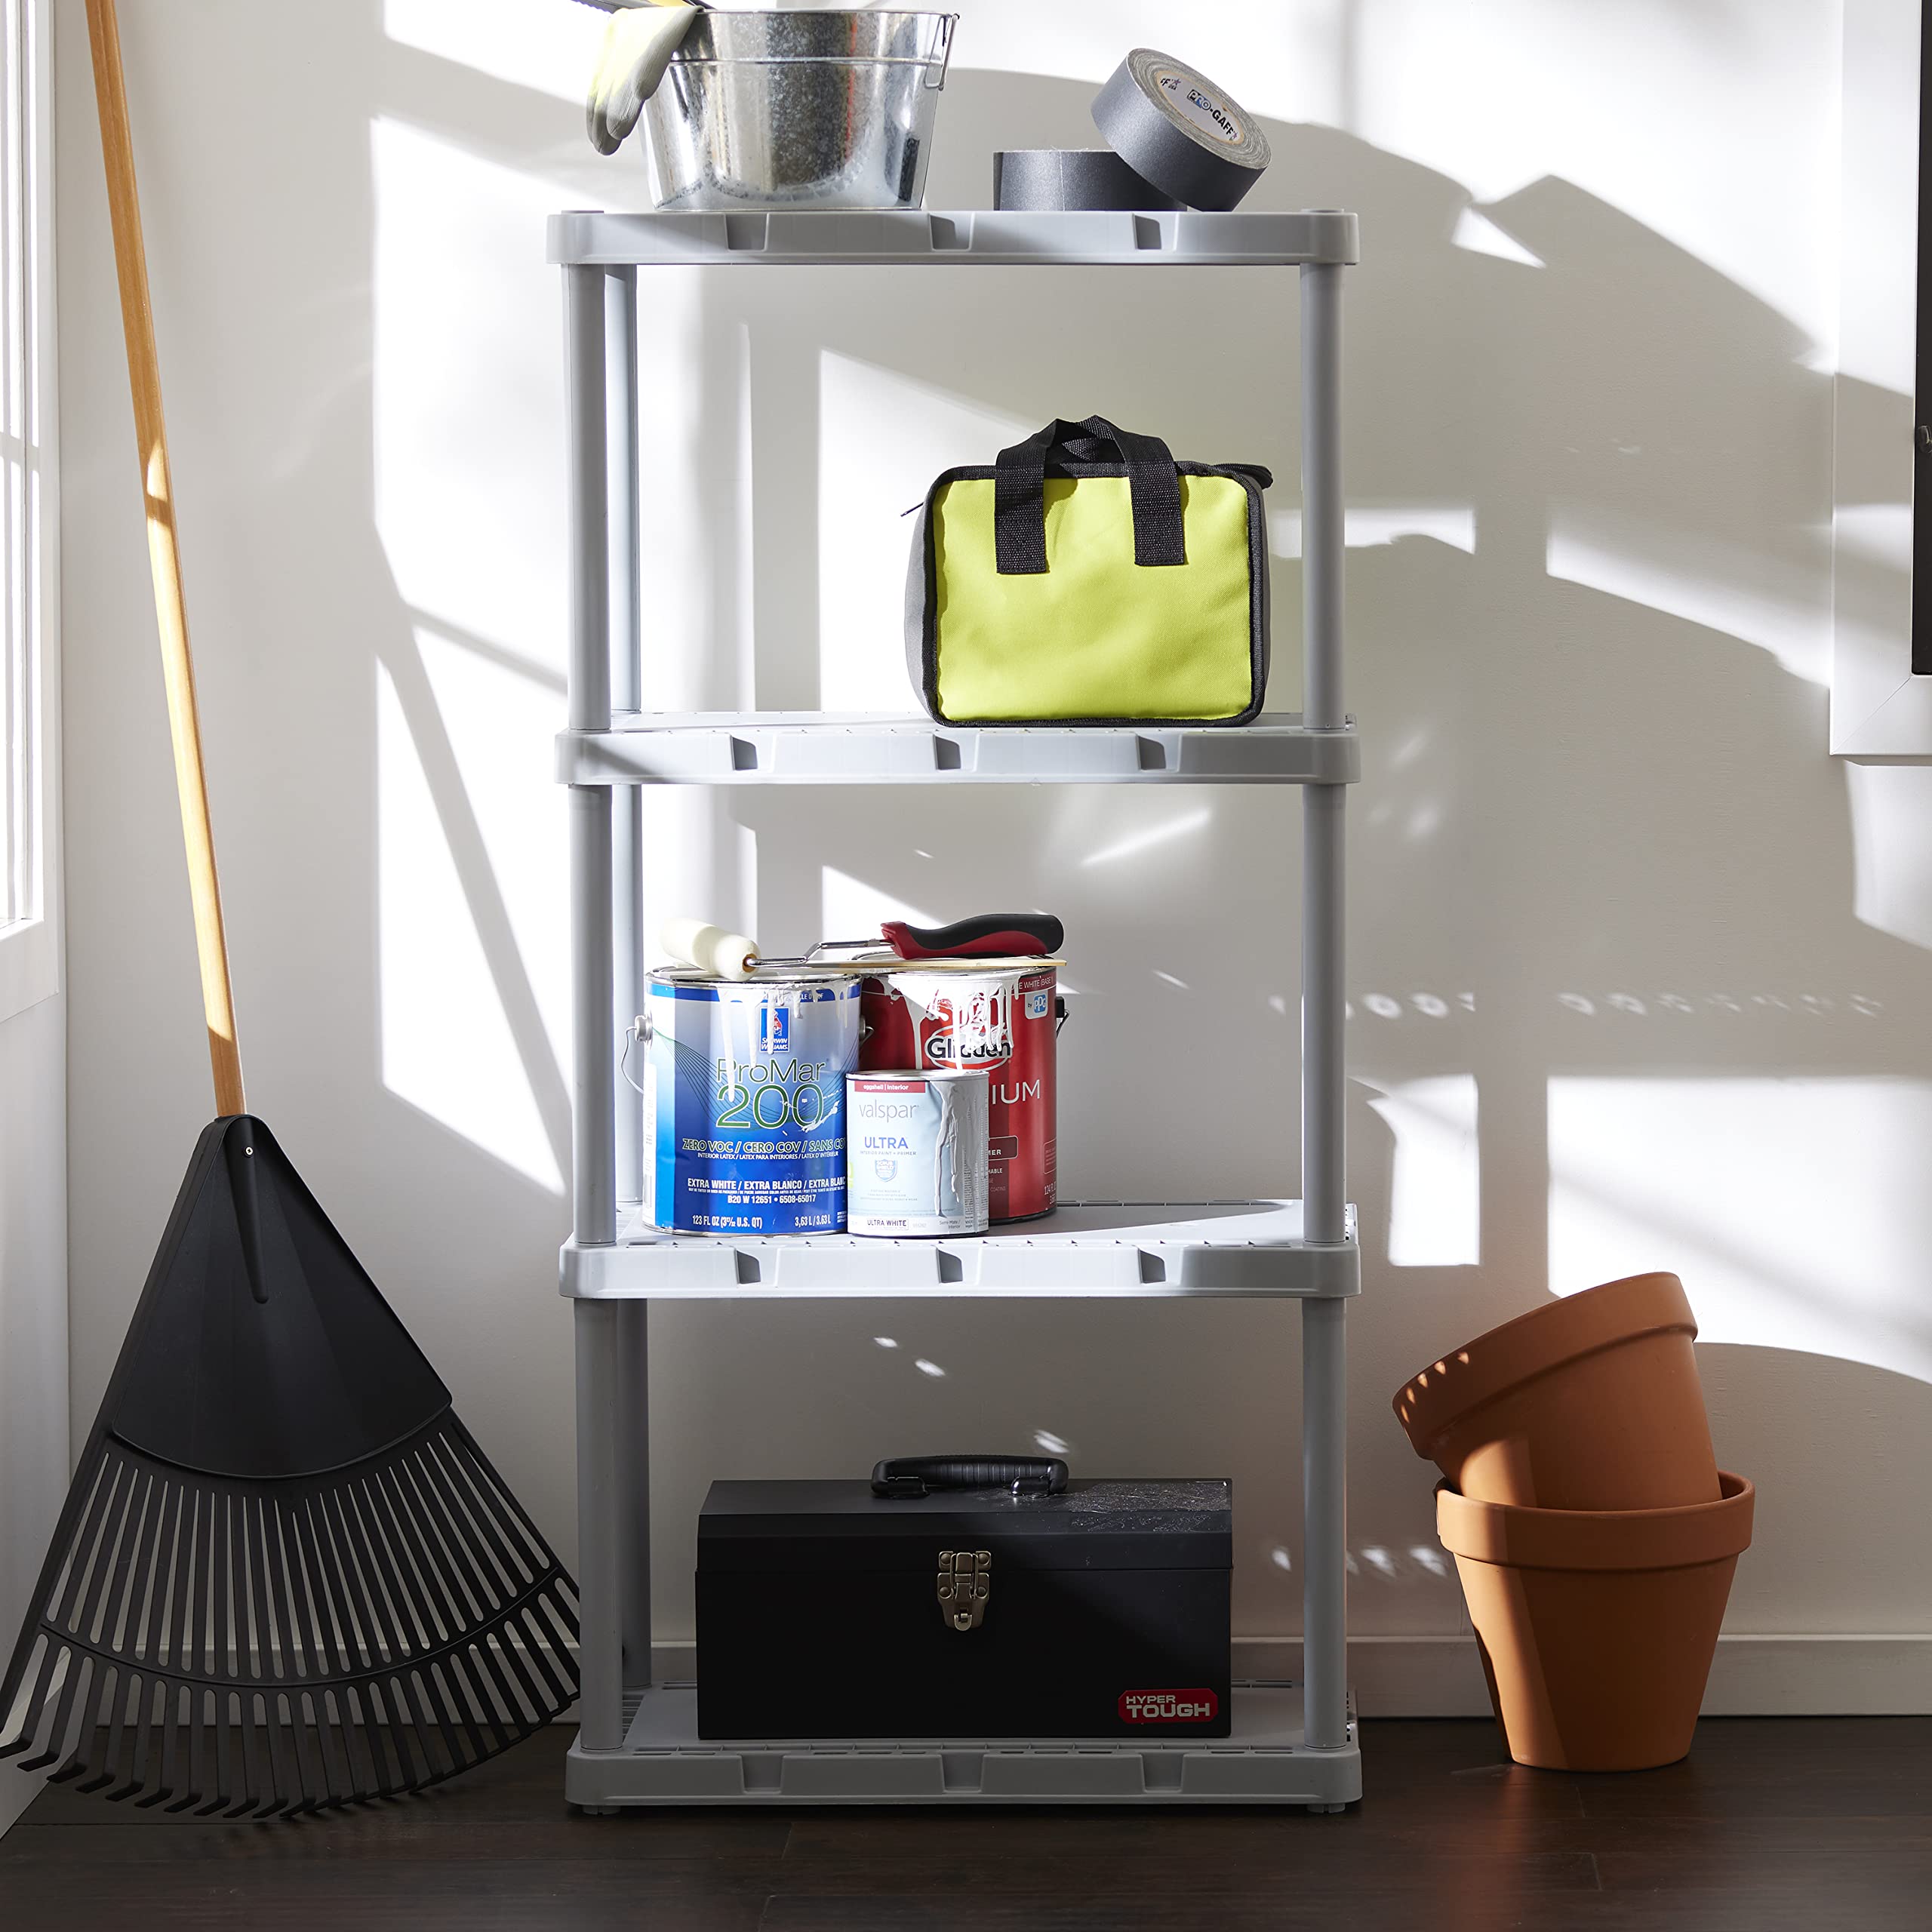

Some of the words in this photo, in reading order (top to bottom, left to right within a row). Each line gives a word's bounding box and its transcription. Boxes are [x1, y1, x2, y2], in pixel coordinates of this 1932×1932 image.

[1187, 89, 1234, 135] PRO-GAFF
[1023, 980, 1040, 989] WHITE
[1034, 996, 1046, 1011] PPG
[717, 1057, 826, 1084] ProMar
[716, 1083, 824, 1129] 200
[859, 1099, 917, 1123] valspar
[682, 1138, 707, 1152] ZERO
[708, 1140, 733, 1153] VOC
[743, 1141, 774, 1154] CERO
[776, 1140, 801, 1153] COV
[808, 1139, 833, 1152] SANS
[834, 1137, 845, 1149] CO
[864, 1137, 909, 1149] ULTRA
[688, 1178, 709, 1189] EXTRA
[712, 1180, 737, 1189] WHITE
[743, 1180, 771, 1190] EXTRA
[772, 1180, 802, 1190] BLANCO
[808, 1178, 829, 1189] EXTRA
[728, 1195, 741, 1204] B20
[743, 1195, 750, 1204] W
[751, 1195, 772, 1204] 12651
[779, 1195, 817, 1204] 6508-65017
[692, 1214, 703, 1226] 123
[703, 1215, 711, 1226] FL
[712, 1216, 720, 1226] OZ
[737, 1217, 750, 1227] U.S.
[751, 1217, 763, 1229] QT)
[795, 1217, 808, 1227] 3,63
[816, 1215, 828, 1226] 3.63
[1126, 1695, 1176, 1704] HYPER
[1126, 1703, 1210, 1718] TOUGH
